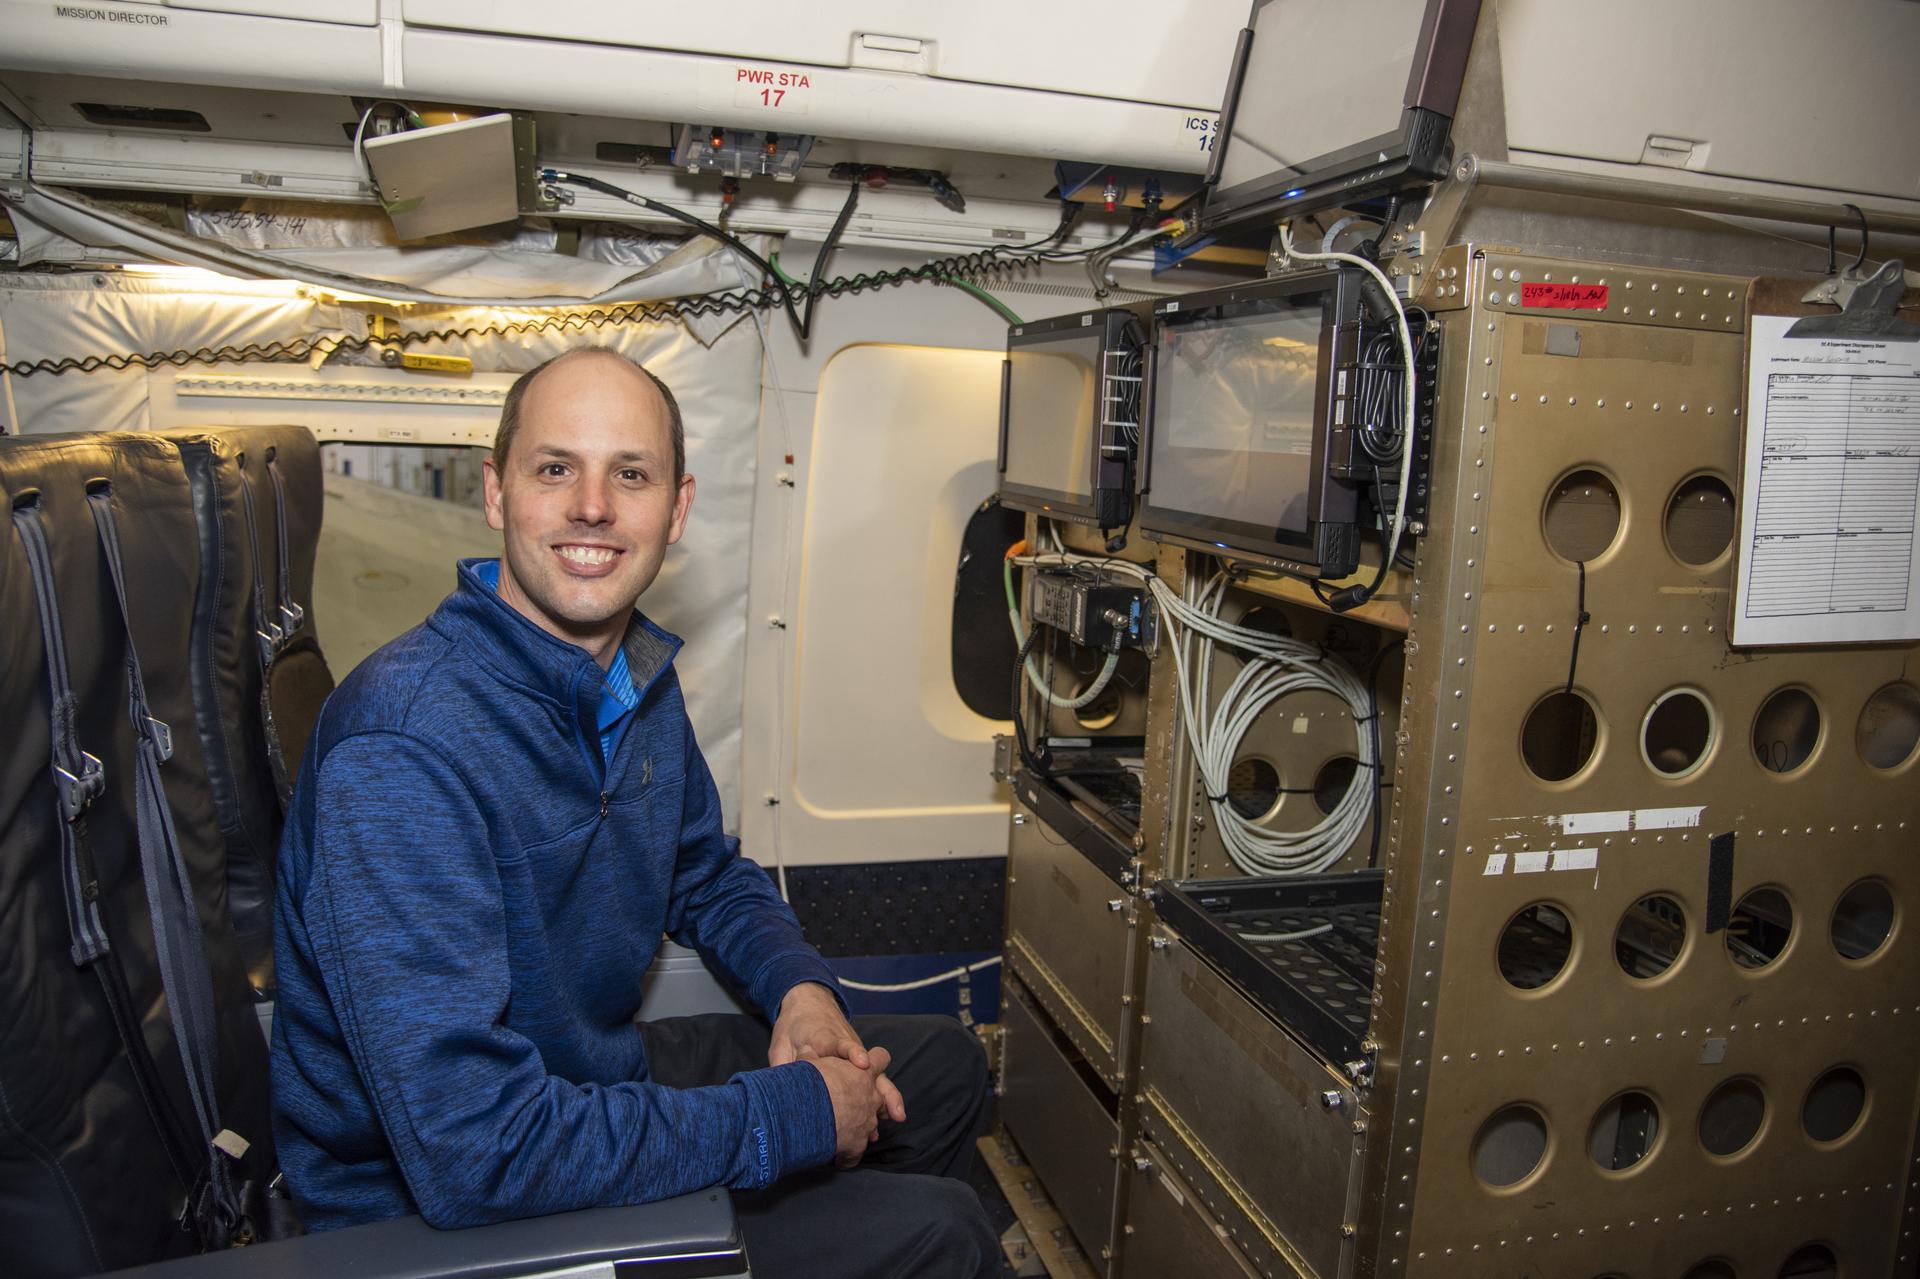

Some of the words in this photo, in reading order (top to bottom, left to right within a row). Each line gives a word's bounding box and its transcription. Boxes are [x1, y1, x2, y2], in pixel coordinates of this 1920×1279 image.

[57, 7, 105, 20] MISSION
[108, 11, 168, 26] DIRECTOR
[737, 69, 774, 85] PWR
[779, 73, 810, 89] STA
[761, 88, 785, 107] 17
[1186, 117, 1209, 131] ICS
[757, 1132, 768, 1180] STORM
